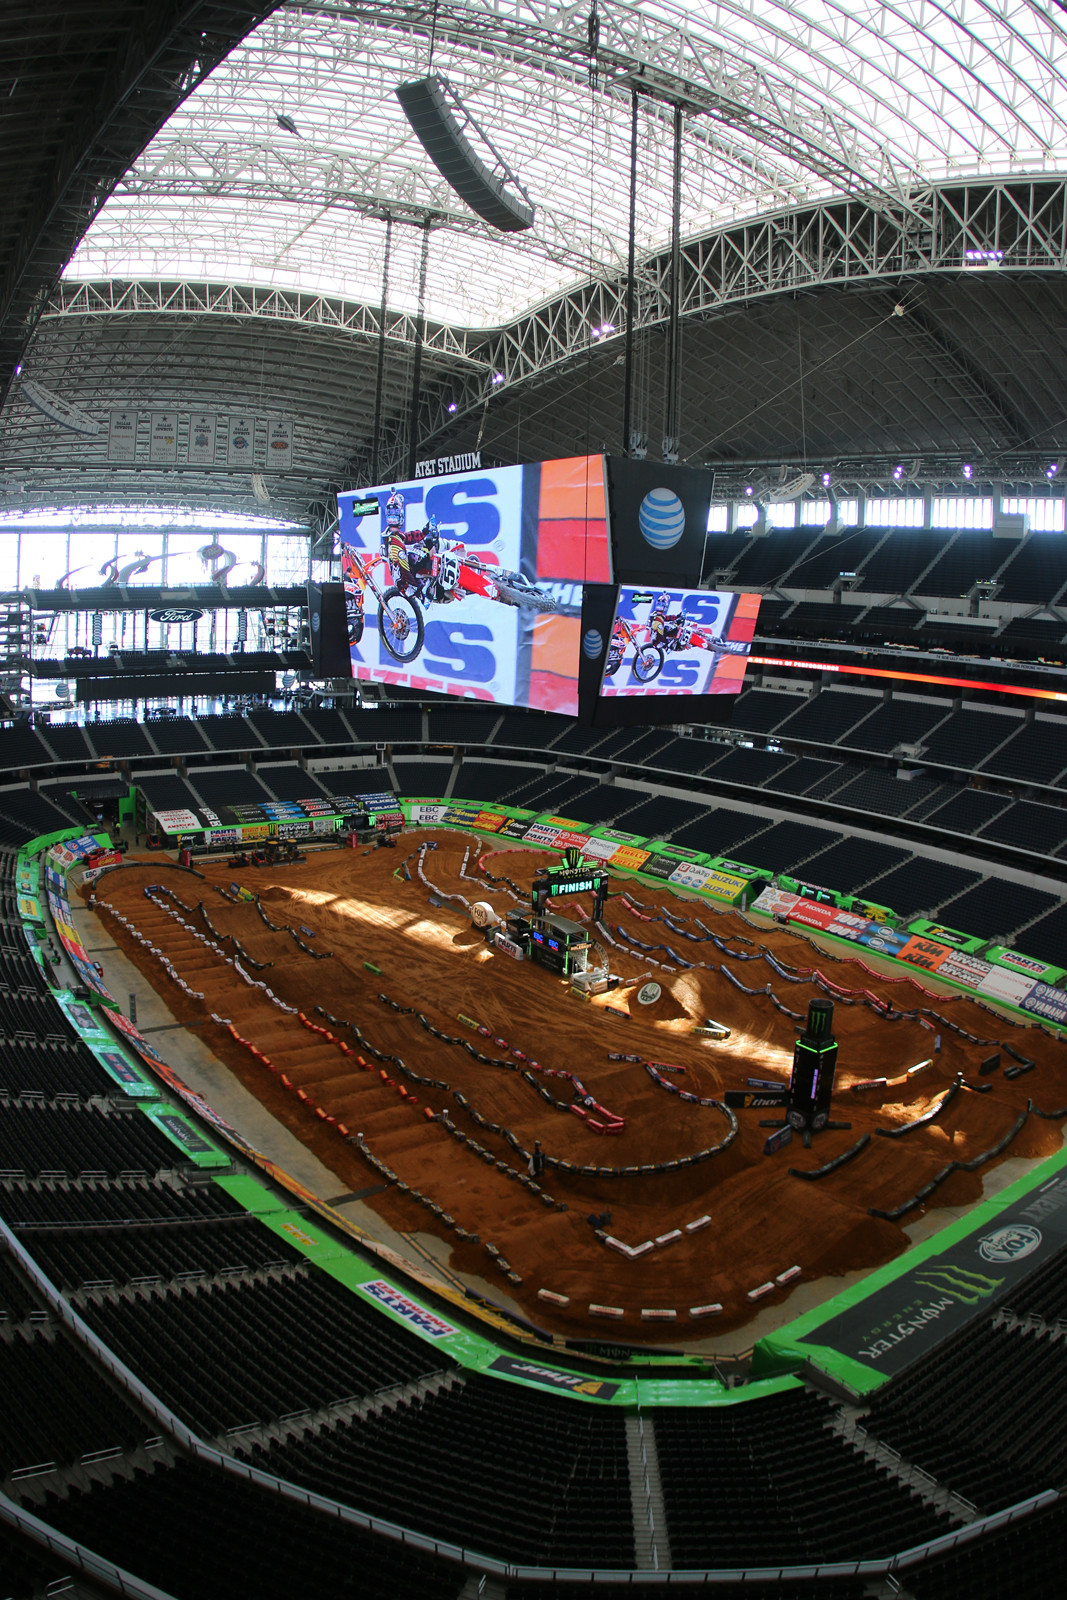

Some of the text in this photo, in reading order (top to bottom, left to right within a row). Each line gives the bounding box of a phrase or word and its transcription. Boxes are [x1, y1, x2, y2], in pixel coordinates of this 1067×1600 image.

[415, 452, 482, 478] AT&T STADIUM
[160, 610, 193, 621] Ford
[794, 662, 839, 671] PERFORMANCE
[533, 825, 560, 834] PARTS
[547, 818, 580, 828] PIRELLI
[525, 833, 553, 842] PARTS
[531, 828, 558, 837] UNLIMITED
[571, 834, 589, 842] TOYOTA
[523, 837, 550, 846] UNLIMITED
[617, 846, 650, 860] PIRELLI
[611, 855, 642, 868] PIRELLI
[86, 870, 97, 878] EBC
[559, 867, 590, 876] MONSTER
[710, 873, 744, 888] SUZUKI
[559, 881, 592, 894] FINISH
[702, 883, 736, 897] SUZUKI
[474, 907, 484, 918] FOX
[806, 904, 831, 916] HONDA
[796, 914, 822, 926] HONDA
[834, 913, 870, 930] 100%
[533, 931, 543, 942] EBC
[825, 923, 862, 940] 100%
[936, 932, 962, 942] thor
[498, 938, 517, 953] PARTS
[548, 939, 558, 949] EBC
[912, 941, 944, 957] KTM
[903, 953, 935, 968] KTM
[1001, 956, 1043, 973] UNLIMITED
[1003, 953, 1048, 971] PARTS
[1034, 1000, 1066, 1020] YAMAHA
[996, 1233, 1034, 1257] FOX
[363, 1284, 446, 1336] PARTS
[376, 1282, 453, 1332] UNLIMITED
[861, 1299, 924, 1342] ENERGY
[858, 1297, 954, 1360] MONSTER
[511, 1363, 583, 1384] thor
